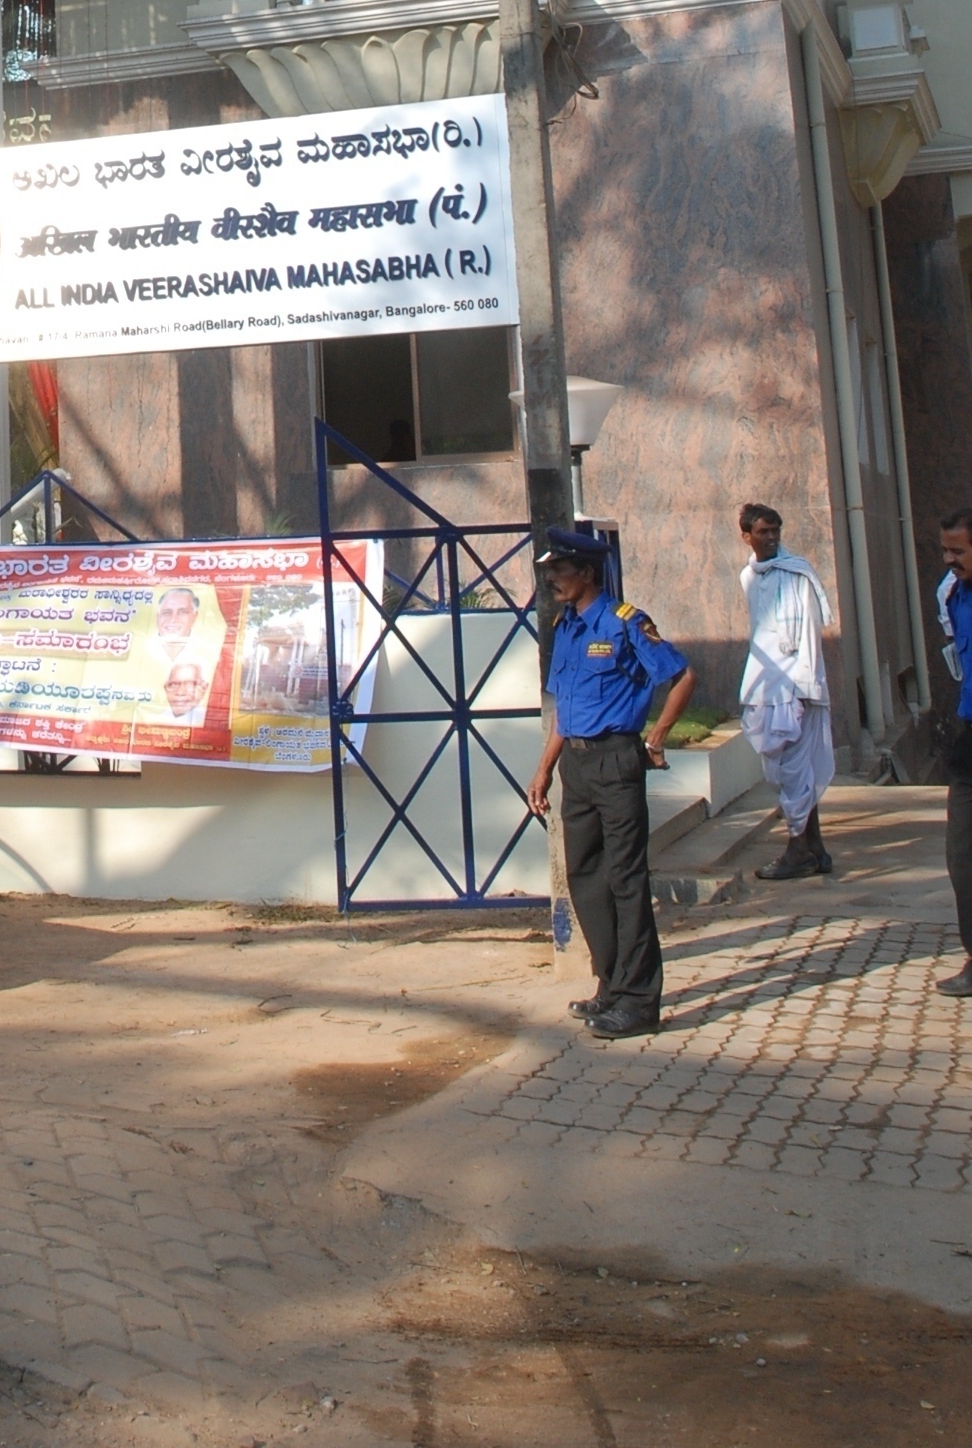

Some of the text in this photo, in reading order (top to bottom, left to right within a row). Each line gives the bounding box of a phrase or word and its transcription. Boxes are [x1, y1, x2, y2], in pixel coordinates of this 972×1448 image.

[13, 164, 80, 191] ಅಖಿಲ
[94, 149, 165, 189] ಭಾರತ
[180, 137, 283, 188] ವೀರಶೈವ
[16, 225, 98, 258] अखिल
[108, 213, 202, 250] भारतीय
[211, 202, 300, 241] वीरशैव
[308, 199, 419, 233] महासभा
[15, 288, 55, 309] ALL
[61, 281, 119, 306] INDIA
[123, 267, 282, 302] VEERASHAIVA
[286, 253, 441, 289] MAHASABHA
[121, 323, 170, 337] Maharshi
[287, 306, 382, 325] Sadashivanagar,
[386, 302, 451, 318] Bangalore-
[453, 299, 474, 311] 560
[477, 297, 499, 310] 080
[79, 550, 177, 576] ವೀರಶೈವ
[188, 548, 309, 571] ಮಹಾಸಭಾ
